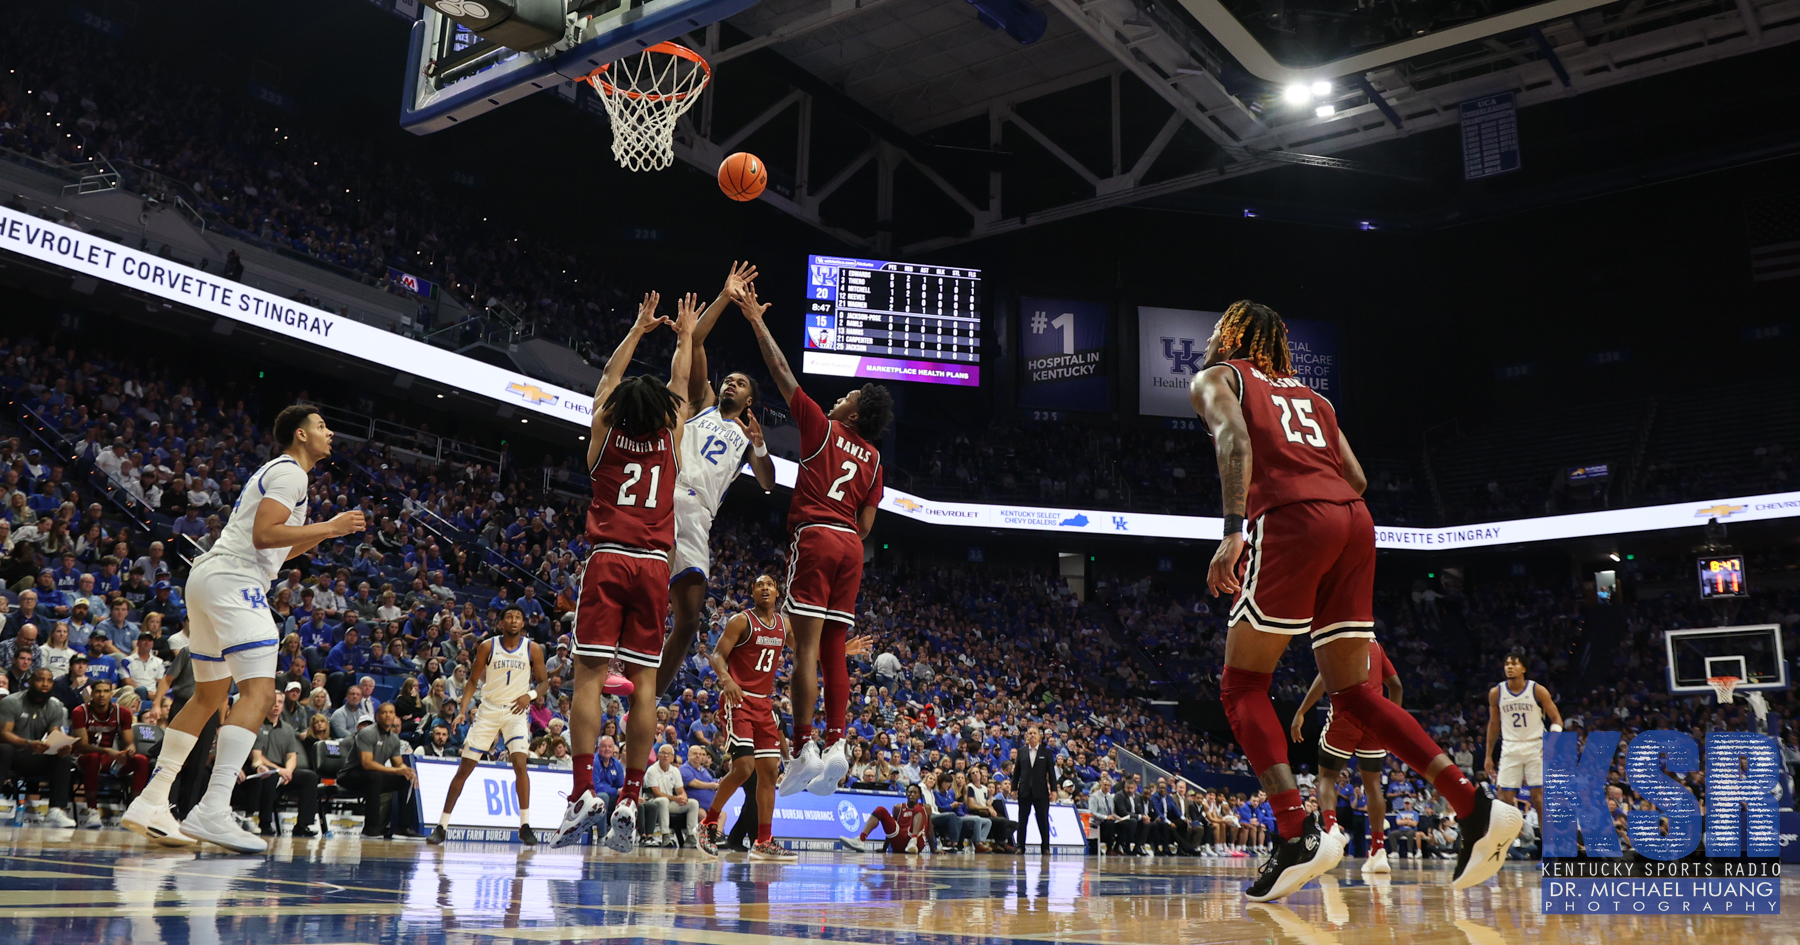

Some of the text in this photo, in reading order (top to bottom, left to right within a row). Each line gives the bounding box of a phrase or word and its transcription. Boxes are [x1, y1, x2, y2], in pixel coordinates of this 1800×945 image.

[1478, 99, 1497, 107] UCA
[848, 270, 871, 278] EDWARDS
[122, 257, 233, 307] CORVETTE
[238, 294, 334, 337] STINGRAY
[816, 287, 828, 299] 20
[812, 303, 830, 312] 8:47
[61, 313, 80, 329] 31
[816, 315, 827, 326] 15
[1031, 311, 1074, 354] #1
[846, 336, 873, 344] CARPENTER
[1028, 352, 1099, 370] HOSPITAL IN
[1160, 337, 1206, 375] UK
[866, 365, 917, 375] MARKETPLACE
[918, 369, 944, 377] HEALTH
[1033, 364, 1096, 381] KENTUCKY
[1314, 366, 1330, 376] OF
[1034, 411, 1057, 421] 235
[1271, 394, 1328, 448] 25
[1172, 420, 1195, 430] 236
[698, 419, 744, 451] KENTUCKY
[616, 435, 653, 452] CARPENTER
[700, 435, 727, 465] 12
[836, 436, 871, 463] RAWLS
[617, 462, 661, 508] 21
[827, 460, 857, 501] 2
[926, 507, 979, 518] CHEVROLET
[1112, 515, 1128, 531] UK
[1375, 527, 1500, 543] CORVETTE STINGRAY
[1710, 559, 1740, 572] 8:47
[241, 587, 268, 609] UK
[493, 660, 526, 670] KENTUCKY
[755, 648, 775, 672] 13
[506, 671, 511, 685] 1
[1502, 703, 1533, 713] KENTUCKY
[1512, 713, 1527, 727] 21
[139, 726, 156, 740] UK
[782, 809, 803, 819] BUREAU
[804, 810, 835, 821] INSURANCE
[466, 830, 484, 840] FARM
[486, 831, 510, 841] BUREAU
